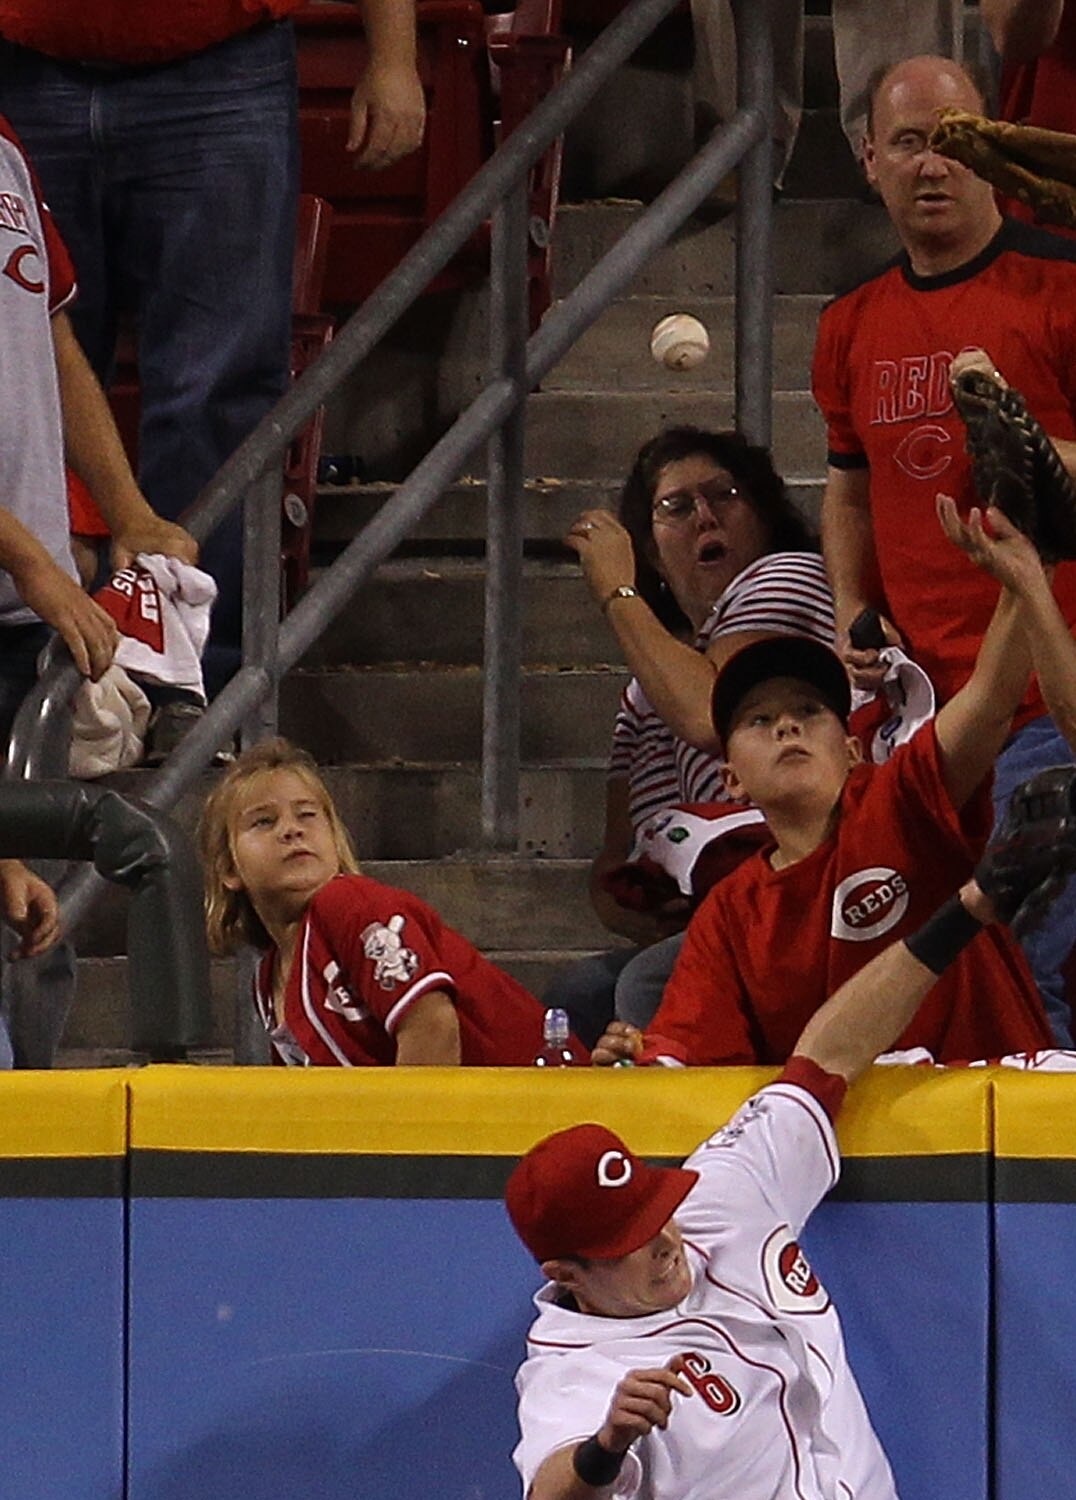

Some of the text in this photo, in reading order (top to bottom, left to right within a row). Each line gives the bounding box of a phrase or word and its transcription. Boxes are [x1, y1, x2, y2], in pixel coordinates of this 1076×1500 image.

[870, 346, 978, 425] RED
[844, 875, 907, 925] REDS
[680, 1351, 742, 1417] 6
